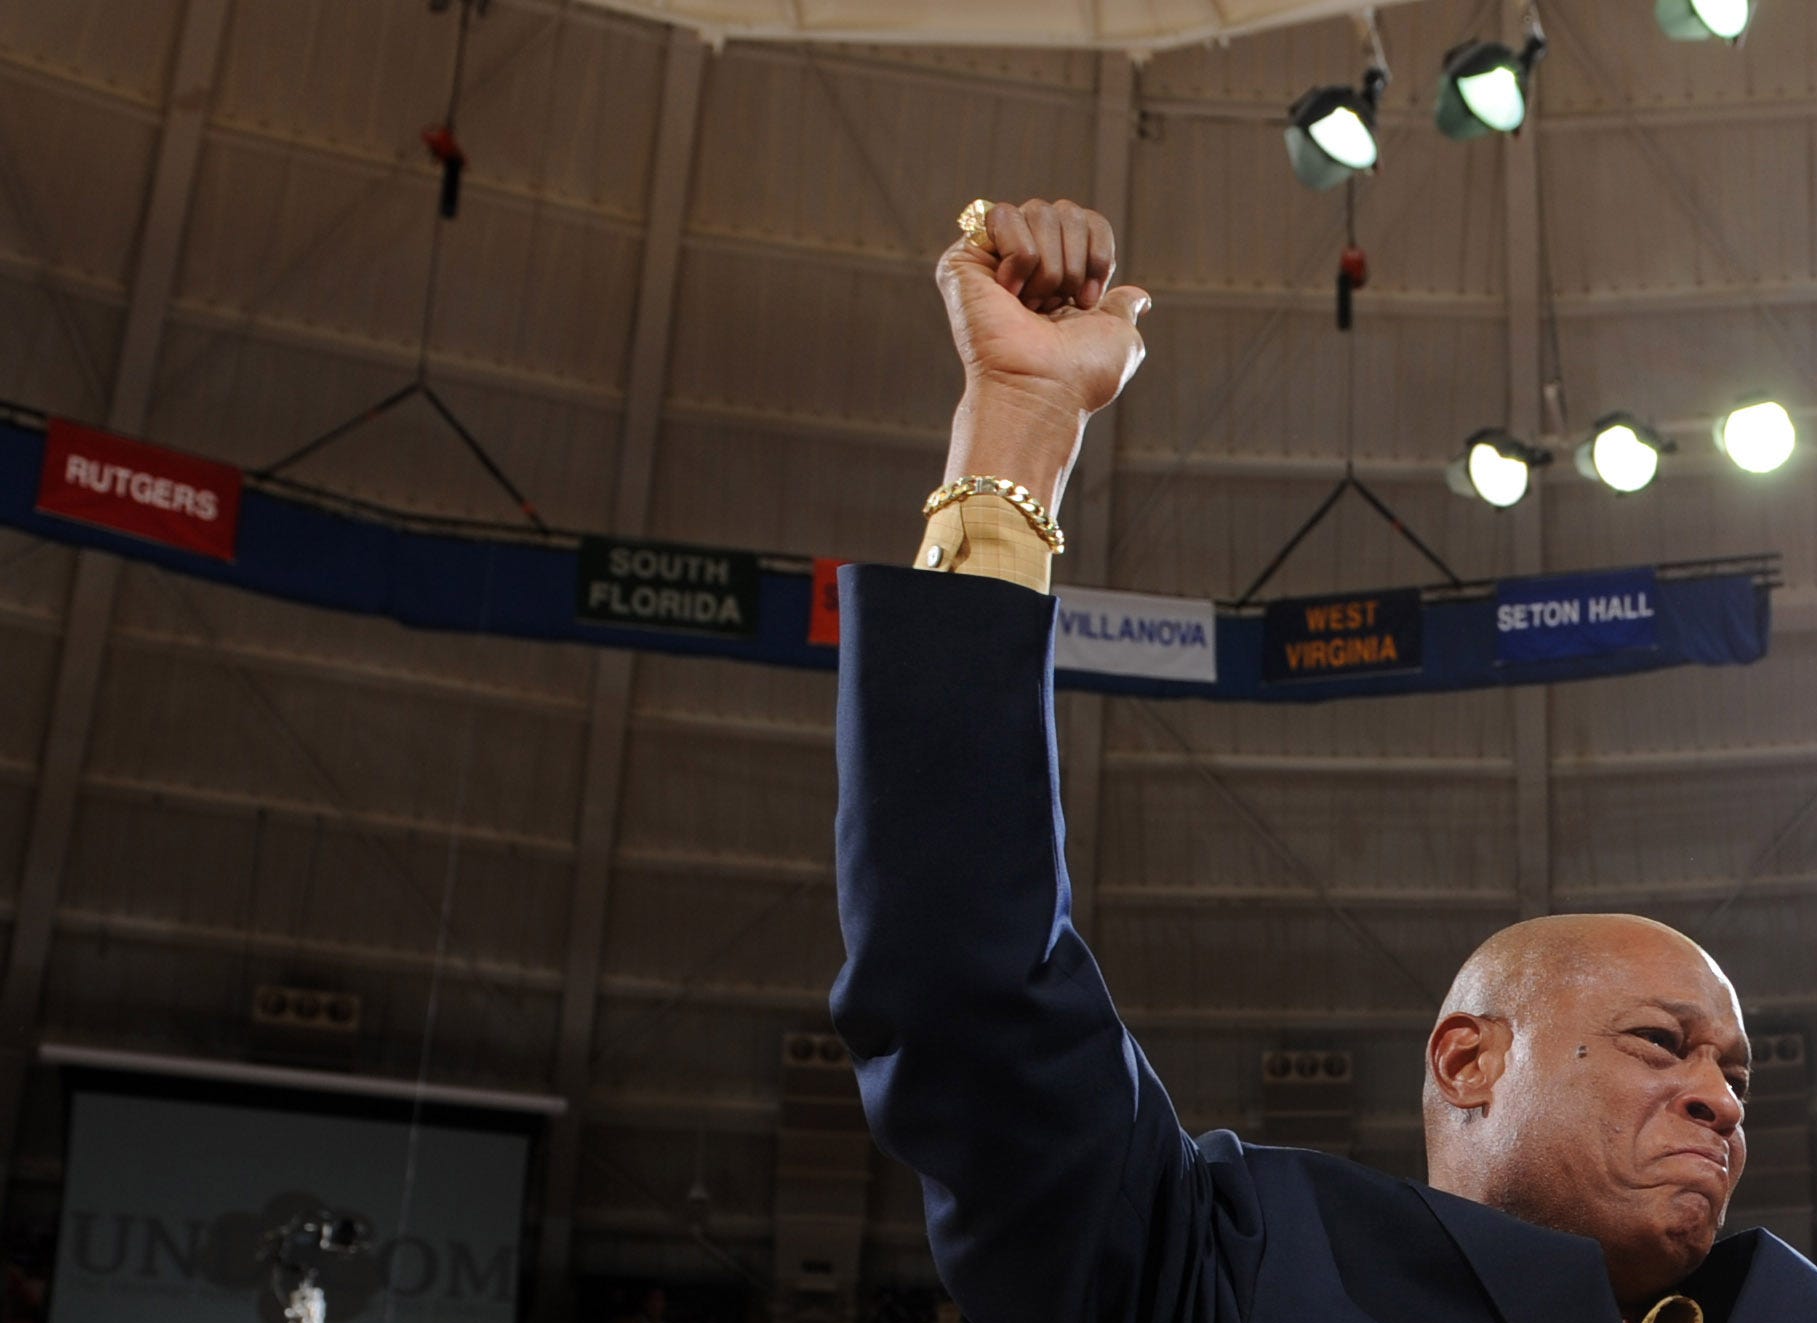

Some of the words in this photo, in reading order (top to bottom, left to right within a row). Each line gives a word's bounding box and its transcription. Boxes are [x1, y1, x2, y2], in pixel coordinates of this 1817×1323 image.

[65, 453, 219, 522] RUTGERS
[608, 546, 730, 585] SOUTH
[588, 580, 742, 625] FLORIDA
[1305, 600, 1380, 633] WEST
[1497, 598, 1580, 632] SETON
[1588, 592, 1655, 623] HALL
[1058, 607, 1207, 648] VILLANOVA
[1284, 634, 1398, 671] VIRGINIA
